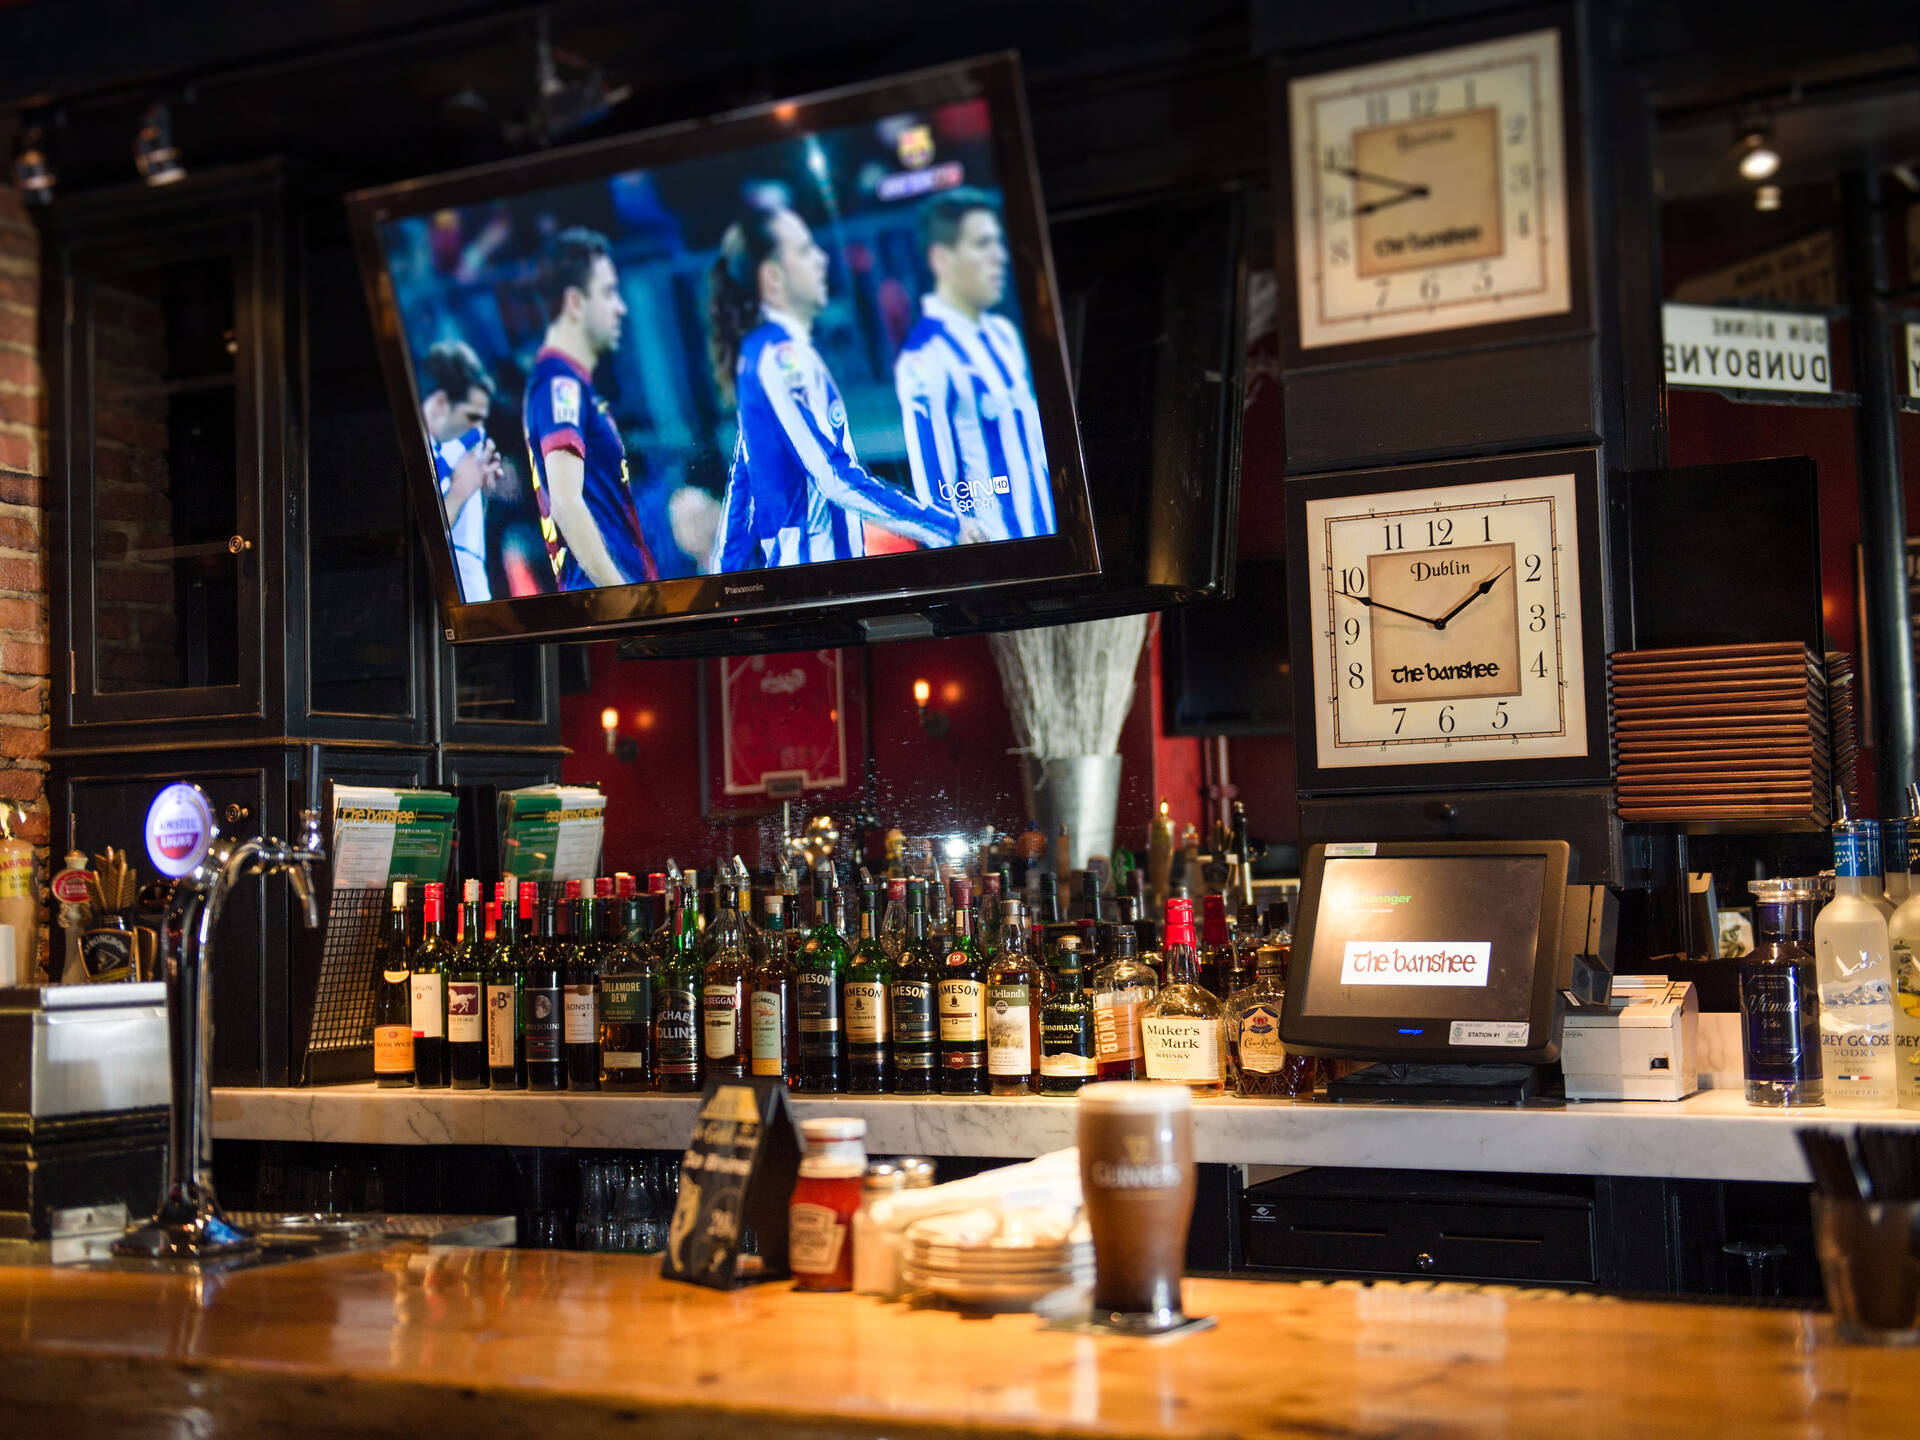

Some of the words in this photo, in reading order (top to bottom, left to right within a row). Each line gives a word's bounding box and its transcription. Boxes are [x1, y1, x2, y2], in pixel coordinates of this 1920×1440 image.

[1383, 523, 1405, 551] 11
[1426, 517, 1453, 547] 12
[1481, 515, 1493, 542] 1
[1340, 566, 1365, 594] 10
[1410, 560, 1471, 582] Dublin
[1525, 553, 1541, 582] 2
[724, 584, 764, 595] Panasonic
[1344, 617, 1360, 645] 9
[1529, 604, 1546, 632] 3
[1349, 662, 1364, 690] 8
[1424, 661, 1500, 680] banshee
[1530, 650, 1548, 678] 4
[1392, 707, 1406, 734] 7
[1438, 705, 1455, 733] 6
[1492, 701, 1508, 729] 5
[367, 806, 415, 825] banshee
[1394, 949, 1477, 973] banshee
[601, 980, 640, 993] TULLAMORE
[611, 993, 628, 1003] DEW
[1097, 1008, 1118, 1053] KNOB
[1147, 1024, 1200, 1035] Maker's
[1822, 1035, 1843, 1046] GREY
[1848, 1035, 1889, 1046] GOOSE
[1161, 1038, 1200, 1049] Mark
